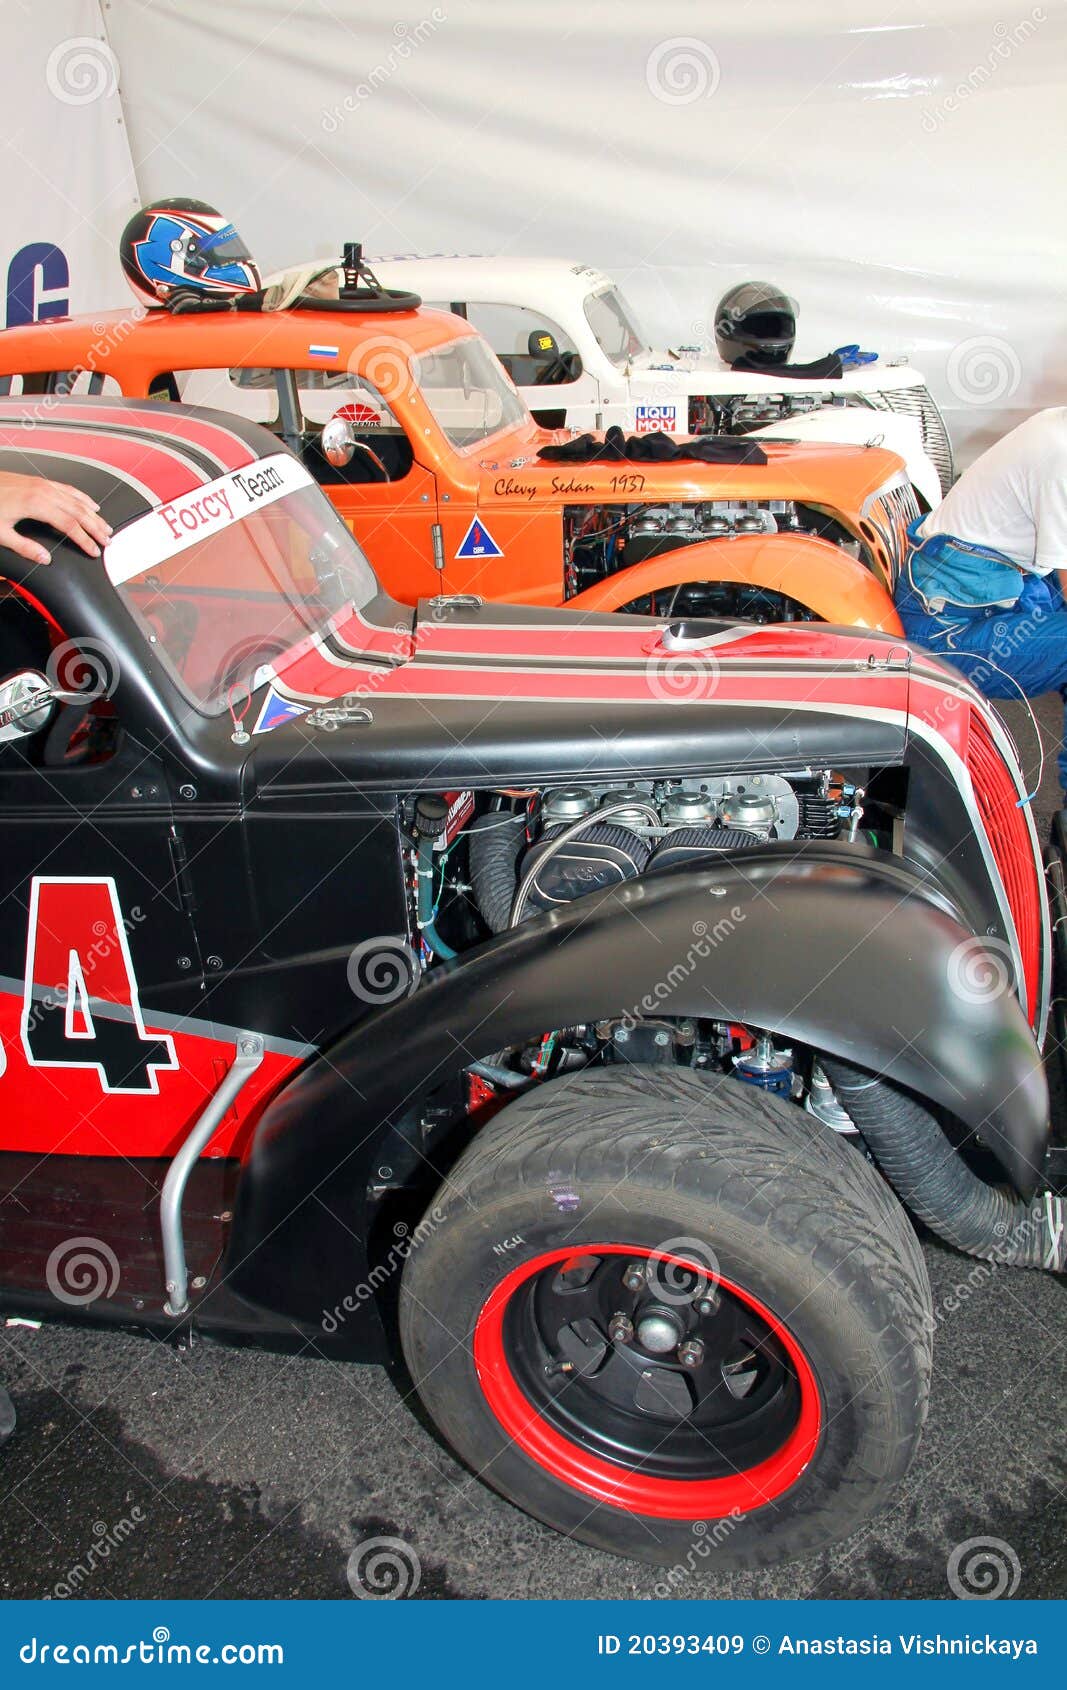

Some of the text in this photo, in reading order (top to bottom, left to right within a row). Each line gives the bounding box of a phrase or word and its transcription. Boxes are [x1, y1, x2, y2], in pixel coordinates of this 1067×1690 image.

[637, 407, 675, 419] LIQUI
[637, 420, 675, 431] MOLY
[494, 474, 646, 500] Chevy Sedan 1937
[157, 465, 284, 539] Forcy Team
